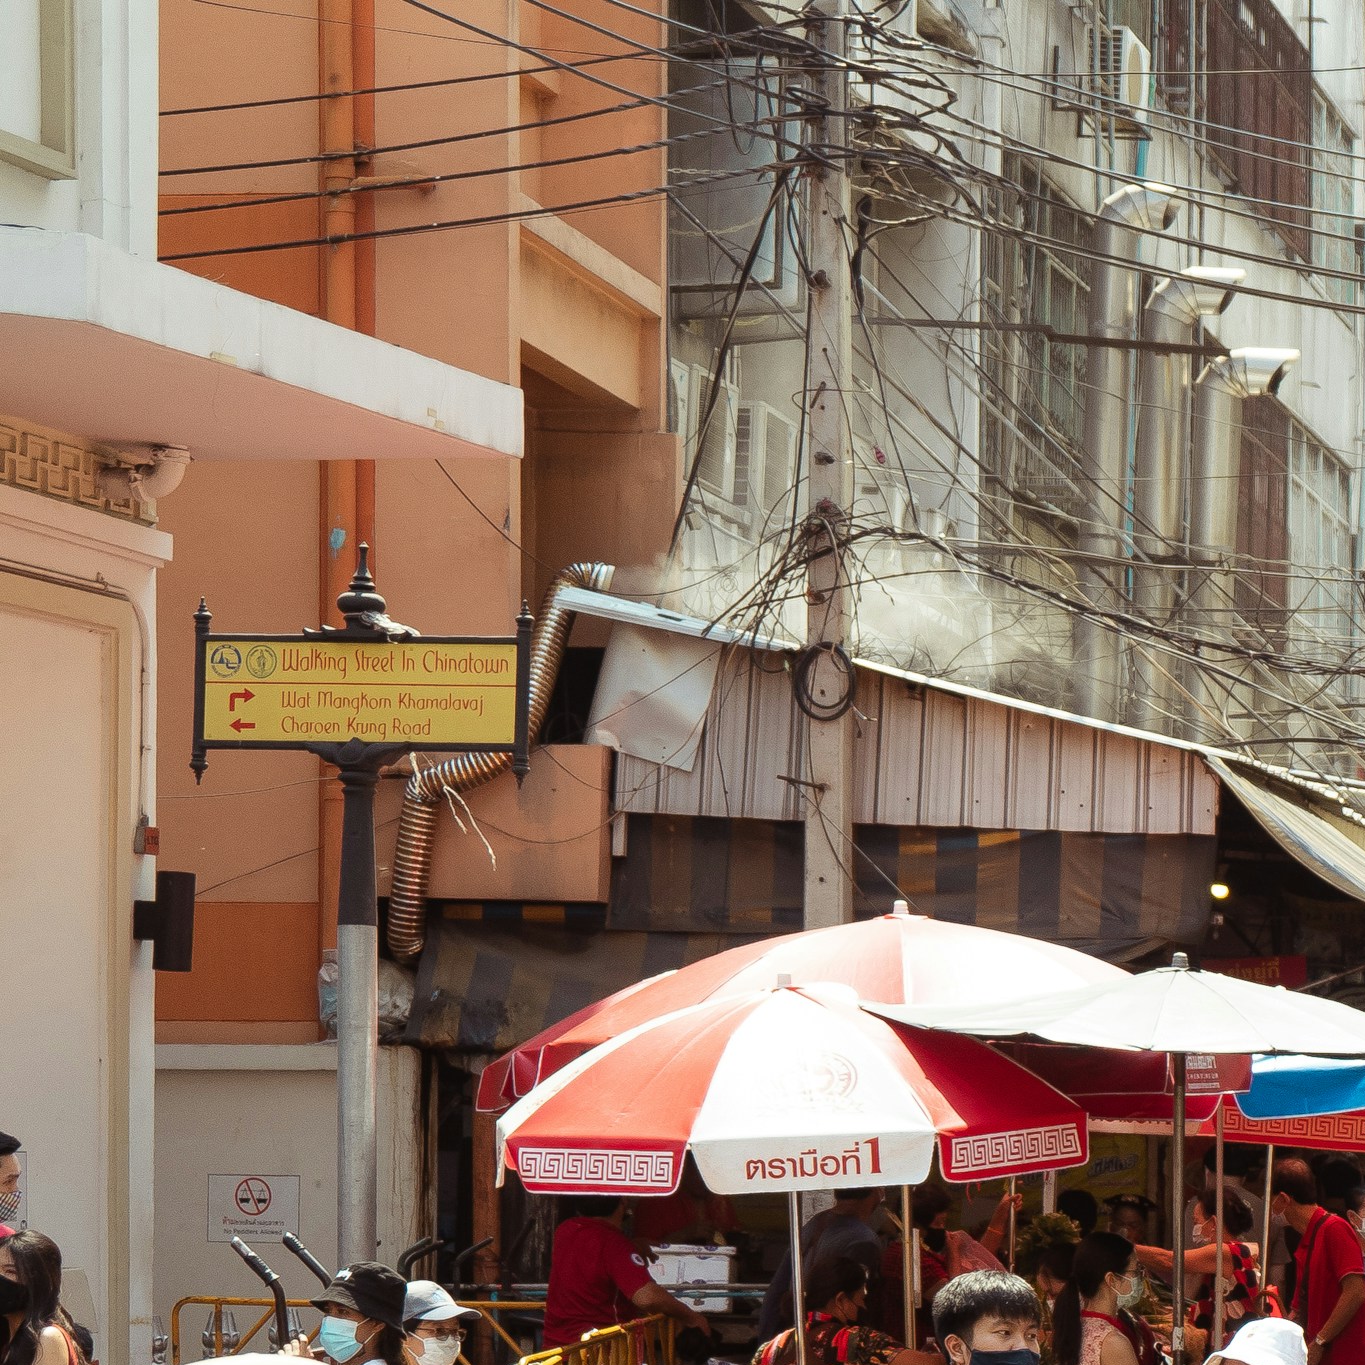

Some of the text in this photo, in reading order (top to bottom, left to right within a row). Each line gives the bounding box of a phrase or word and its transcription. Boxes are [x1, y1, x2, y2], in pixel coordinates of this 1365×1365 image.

[282, 649, 510, 679] Walking Street In Chinatown
[281, 690, 312, 709] Wat
[398, 693, 484, 716] Khamalavaj
[281, 716, 431, 739] Charoen Krung Road
